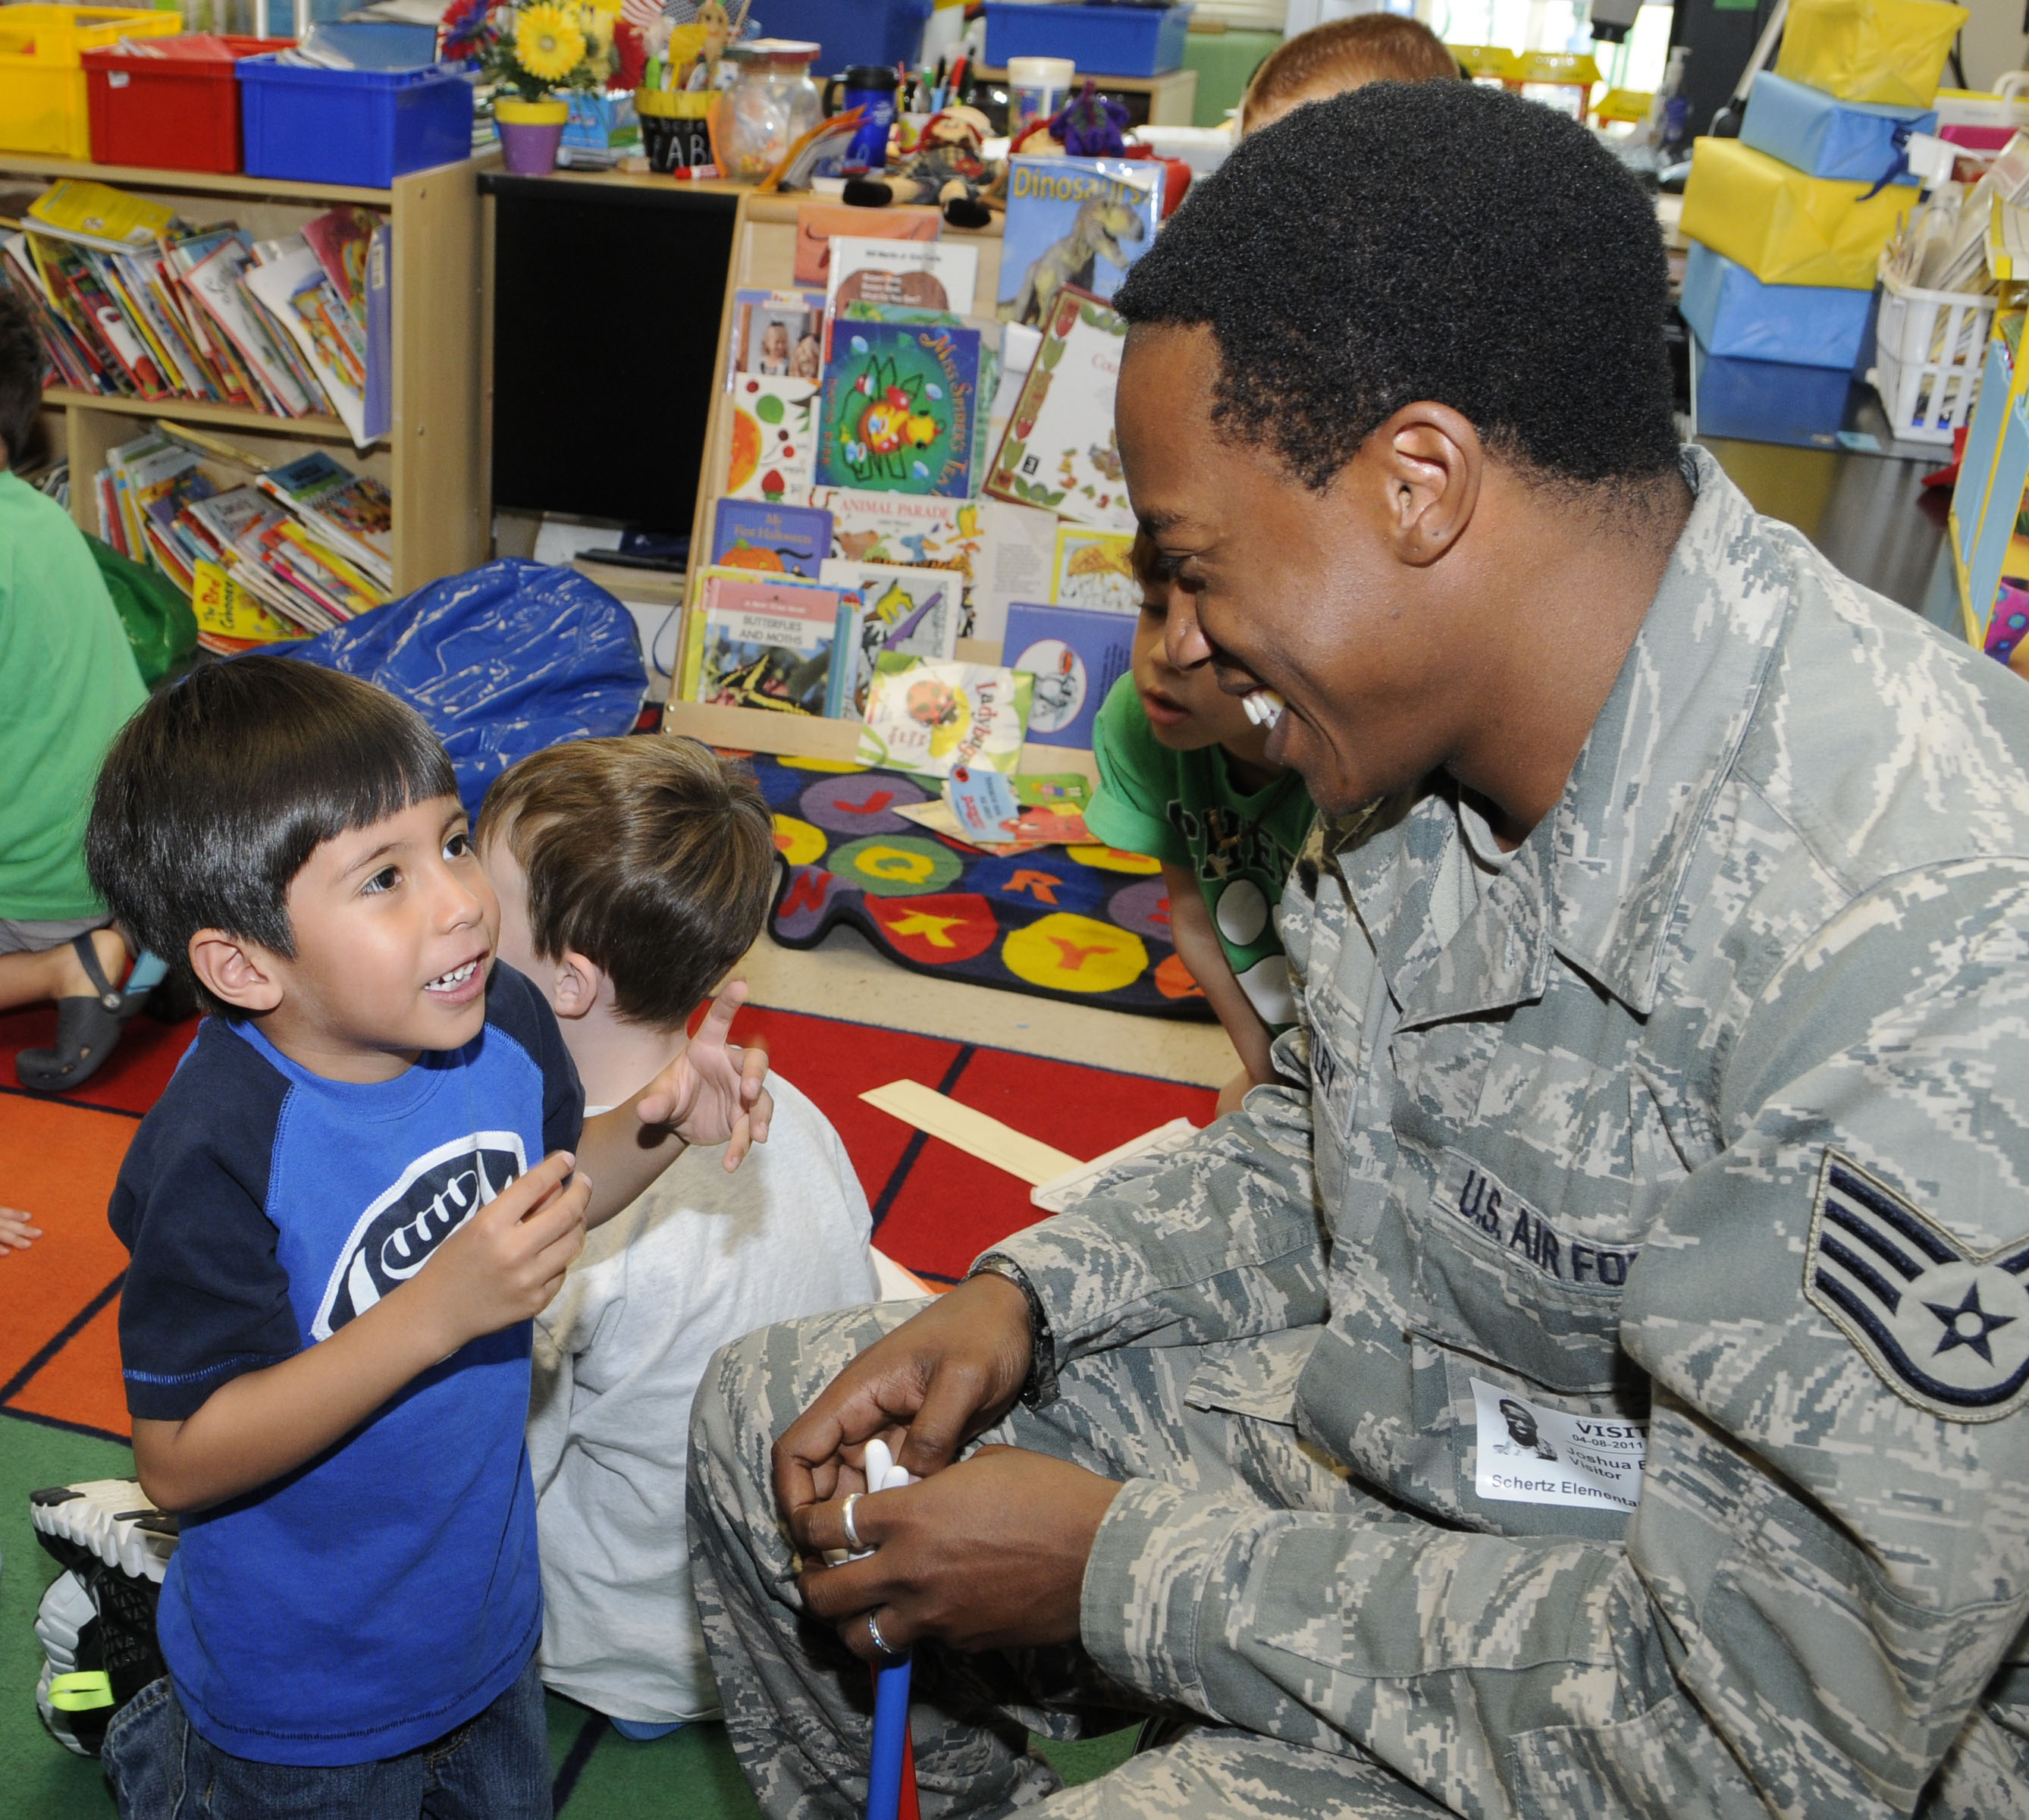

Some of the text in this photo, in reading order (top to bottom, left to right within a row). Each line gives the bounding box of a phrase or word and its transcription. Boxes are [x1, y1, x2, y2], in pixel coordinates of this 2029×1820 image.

[739, 629, 803, 645] AND MOTHS
[1509, 1207, 1562, 1279] AIR
[1572, 1434, 1643, 1449] 04-08-2011
[1566, 1447, 1632, 1470] Joshua
[1569, 1455, 1622, 1480] Visitor
[1491, 1474, 1557, 1492] Schertz
